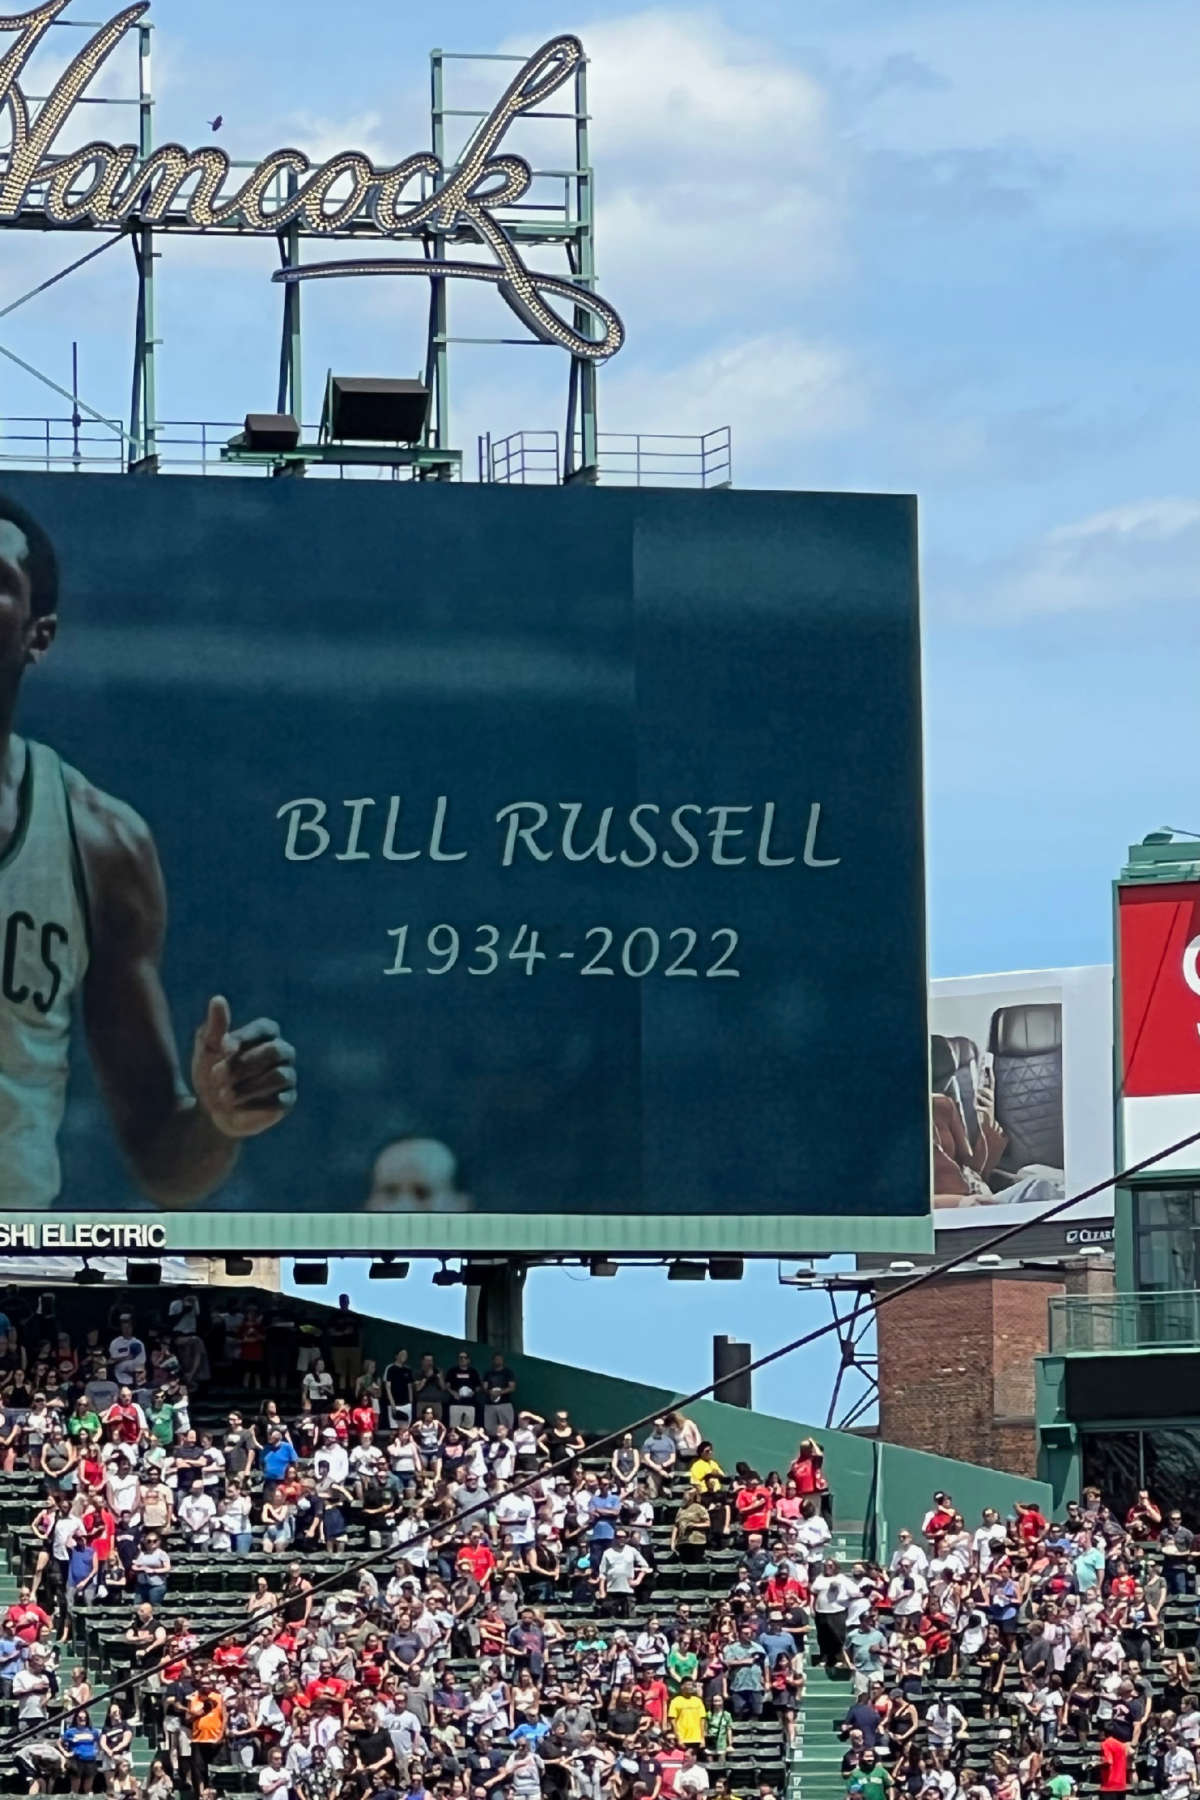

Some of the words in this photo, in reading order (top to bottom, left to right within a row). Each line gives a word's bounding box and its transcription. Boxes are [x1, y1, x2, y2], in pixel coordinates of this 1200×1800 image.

[276, 795, 467, 862] BILL
[496, 801, 841, 868] RUSSELL
[383, 923, 741, 977] 1934-2022
[42, 1222, 167, 1247] ELECTRIC
